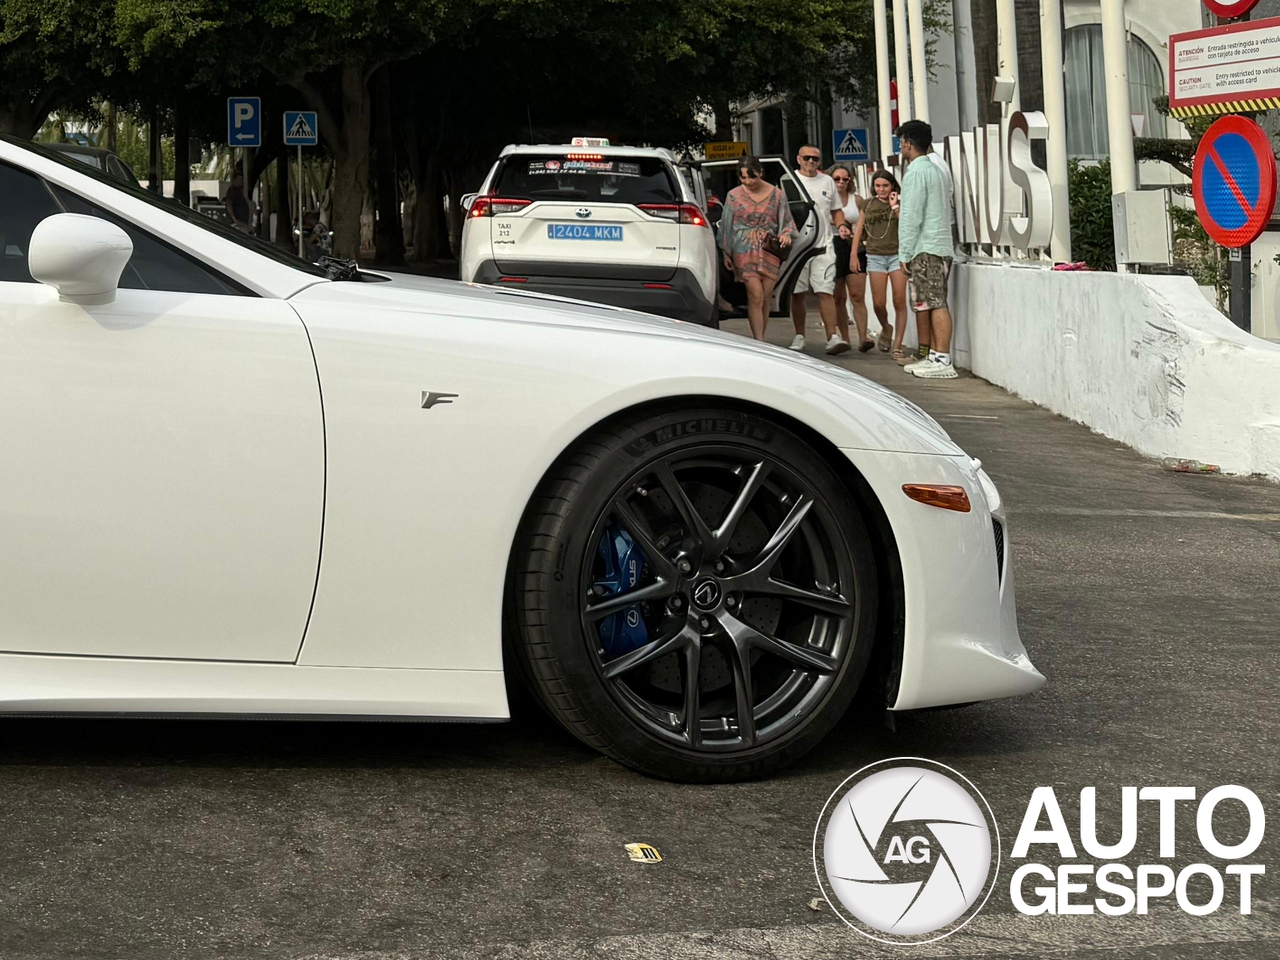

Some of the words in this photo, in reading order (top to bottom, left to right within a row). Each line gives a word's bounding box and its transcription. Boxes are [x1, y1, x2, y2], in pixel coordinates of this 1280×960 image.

[1179, 46, 1205, 57] ATENCIÓN
[1208, 43, 1227, 52] Entrada
[1227, 39, 1255, 50] restringida
[1217, 50, 1234, 59] tarjeta
[1234, 48, 1241, 56] de
[1242, 47, 1260, 55] acceso
[1216, 72, 1229, 81] Entry
[1229, 69, 1255, 78] restricted
[1255, 68, 1262, 76] to
[1179, 77, 1202, 86] CAUTION
[1216, 79, 1228, 87] with
[1228, 78, 1245, 86] access
[1245, 76, 1258, 84] card
[234, 102, 255, 129] P
[556, 226, 590, 238] 2404
[594, 228, 620, 239] MKM
[655, 419, 768, 443] MICHELIN
